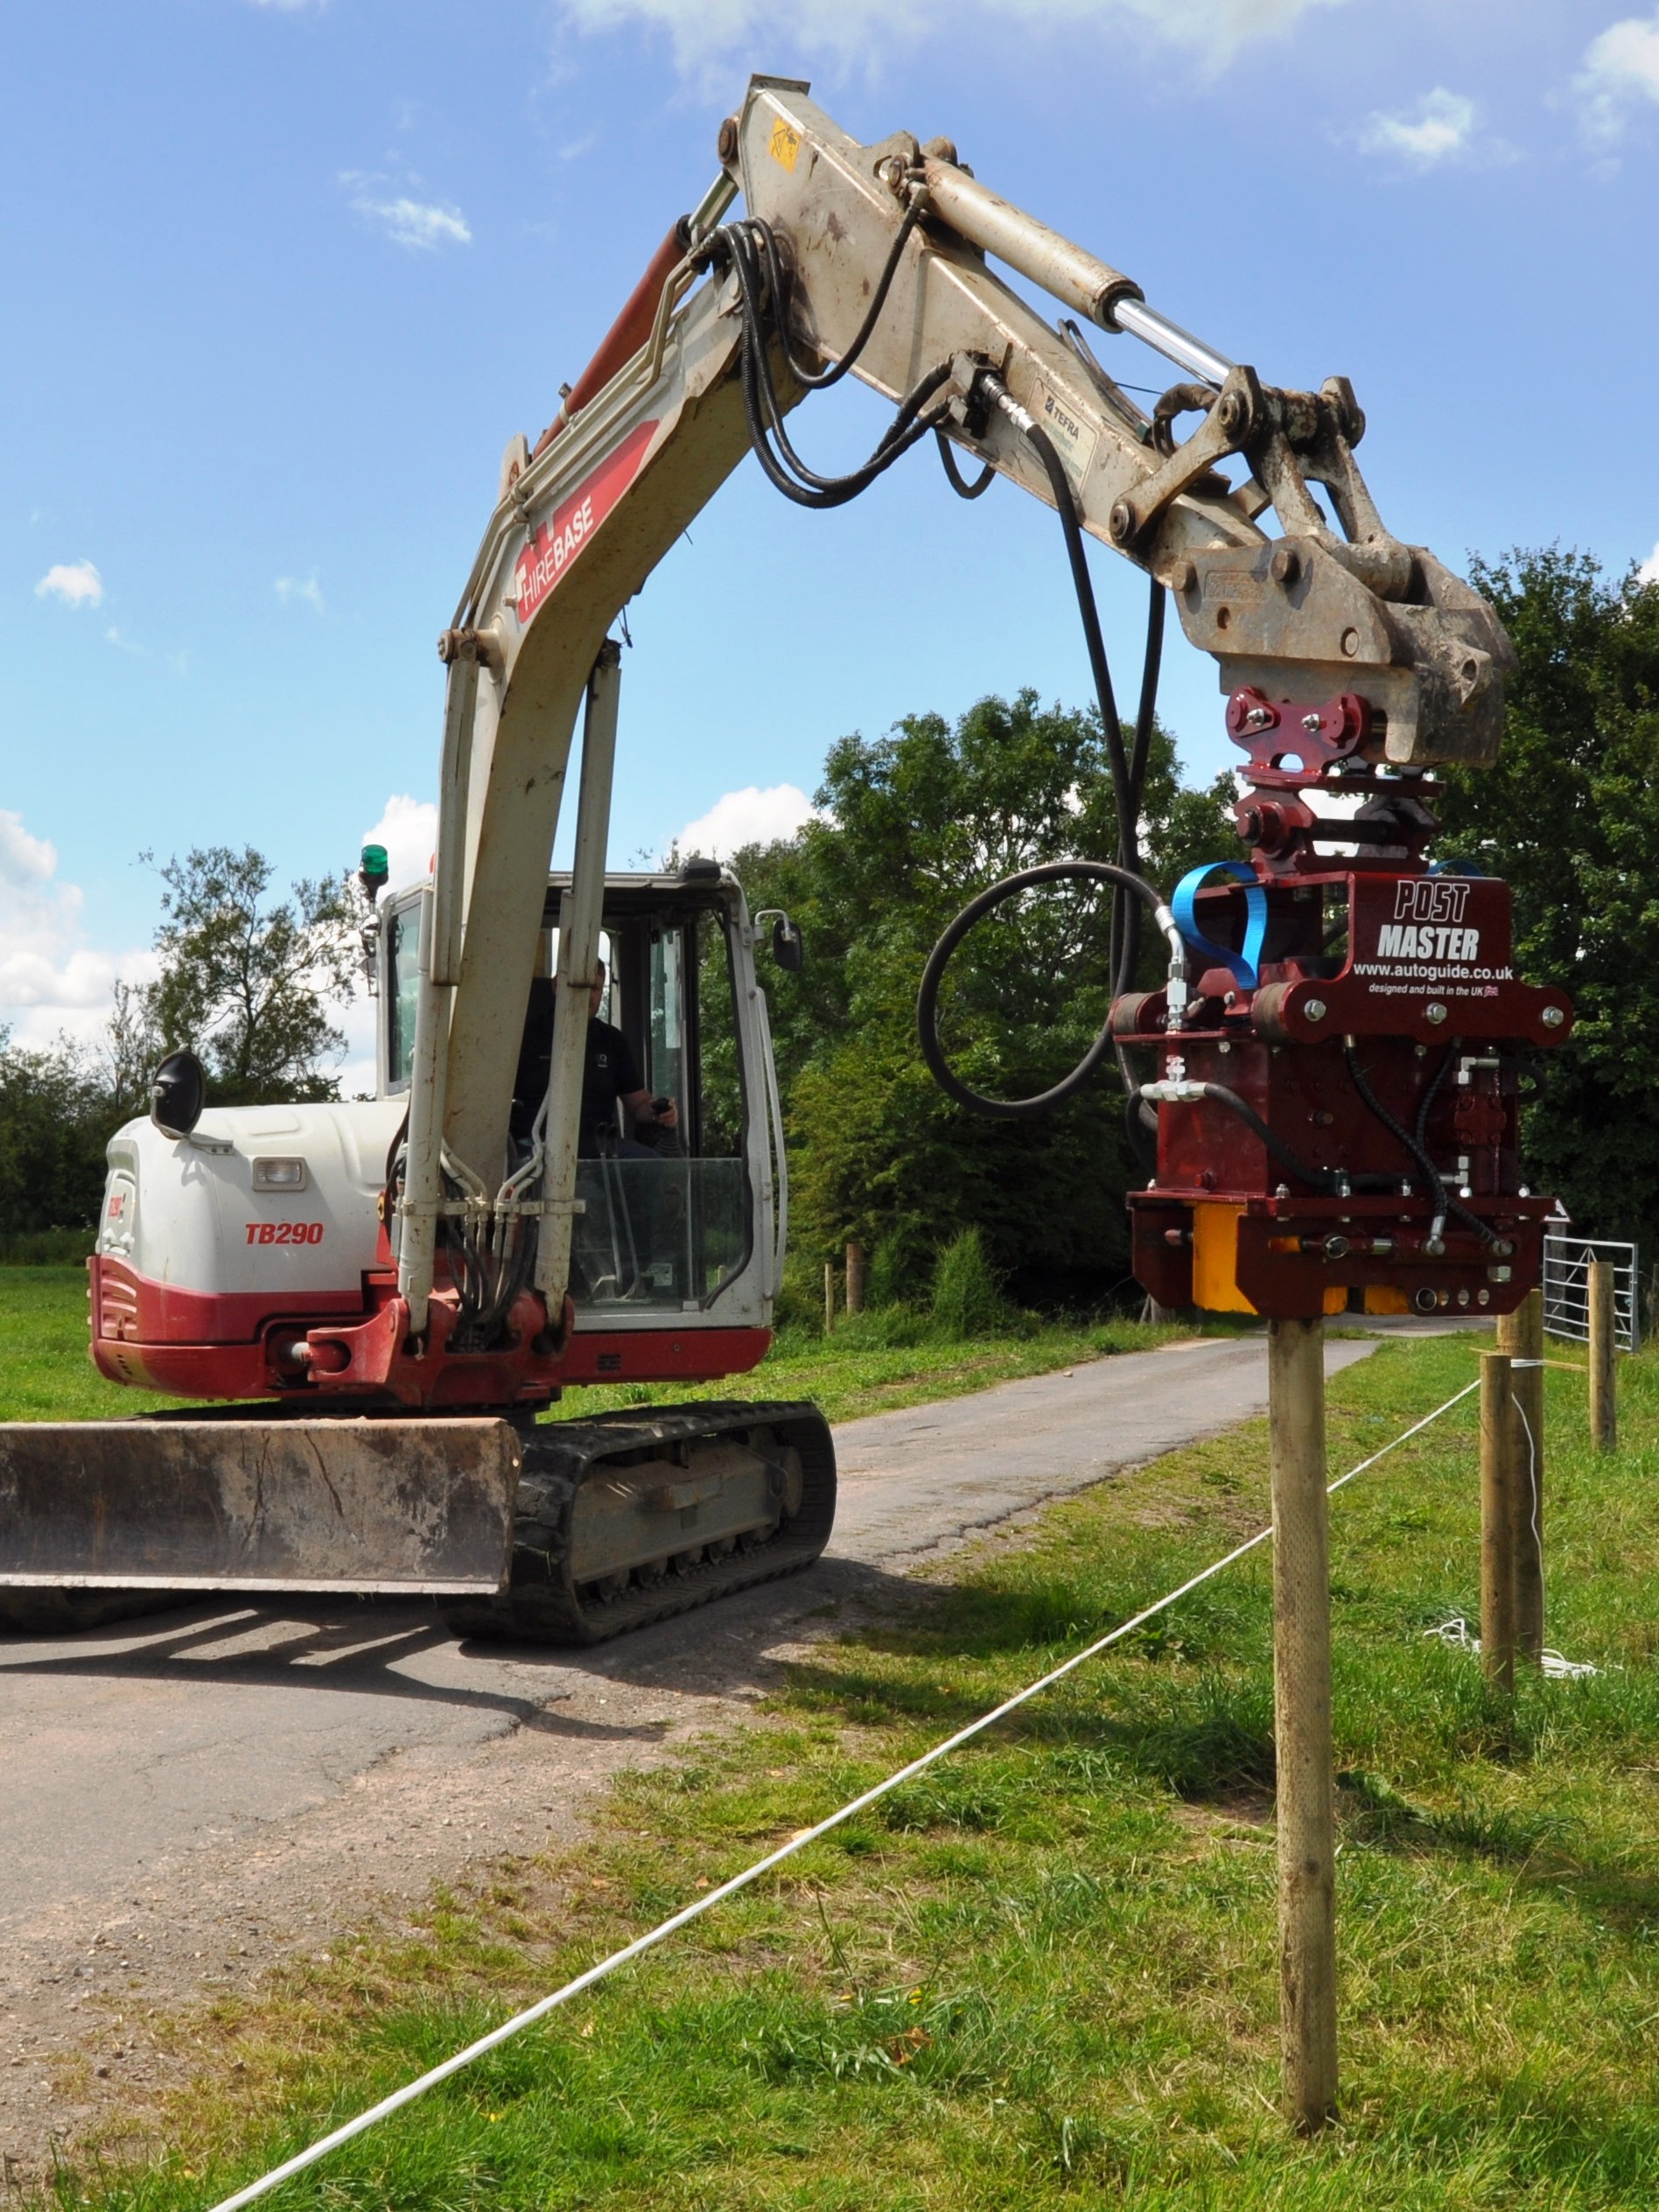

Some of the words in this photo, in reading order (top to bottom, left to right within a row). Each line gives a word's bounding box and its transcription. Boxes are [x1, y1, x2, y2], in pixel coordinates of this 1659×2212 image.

[1054, 406, 1080, 440] TEFRA
[522, 495, 594, 611] HIREBASE
[1394, 880, 1470, 922] POST
[1377, 925, 1480, 961] MASTER
[1354, 963, 1513, 981] www.autoguide.co.uk
[1368, 983, 1408, 995] designed
[1409, 984, 1424, 994] and
[1426, 984, 1445, 995] built
[1446, 985, 1454, 995] in
[1456, 985, 1469, 996] the
[1471, 986, 1484, 997] UK
[245, 1222, 325, 1245] TB290
